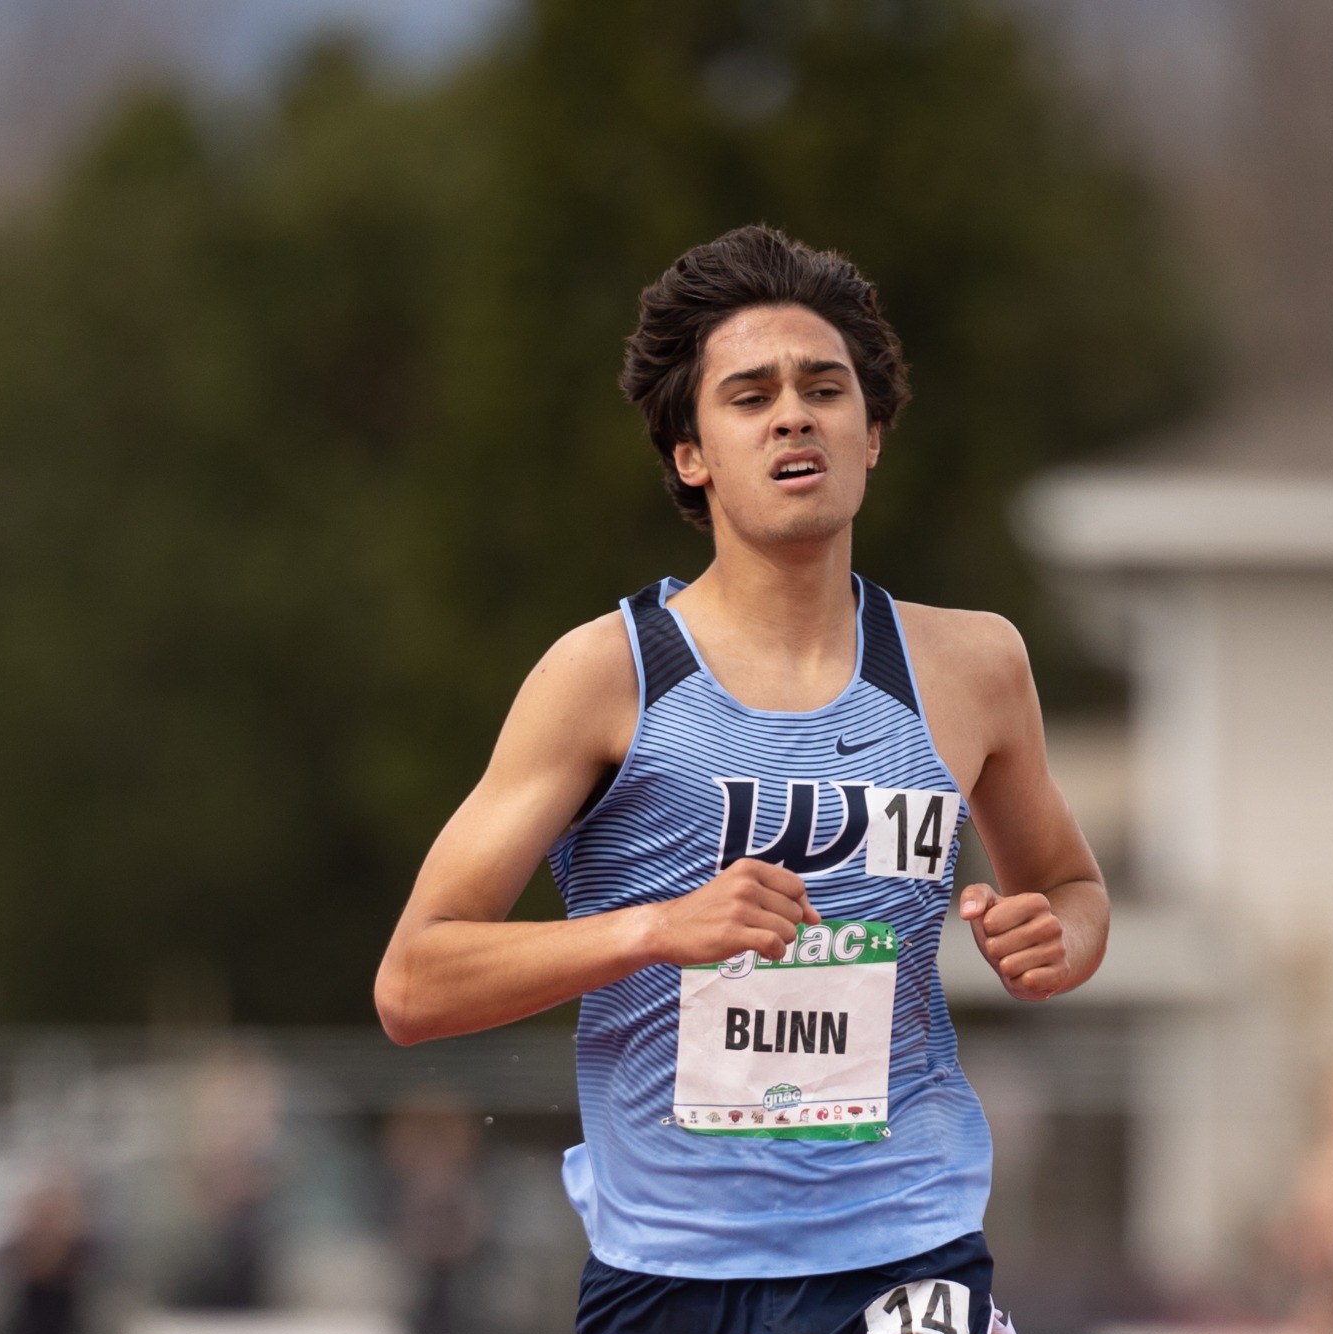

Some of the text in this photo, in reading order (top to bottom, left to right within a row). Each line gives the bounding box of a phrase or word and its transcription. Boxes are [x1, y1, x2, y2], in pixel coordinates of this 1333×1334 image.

[884, 793, 945, 874] 14
[725, 1007, 849, 1055] BLINN
[764, 1090, 801, 1110] gnac
